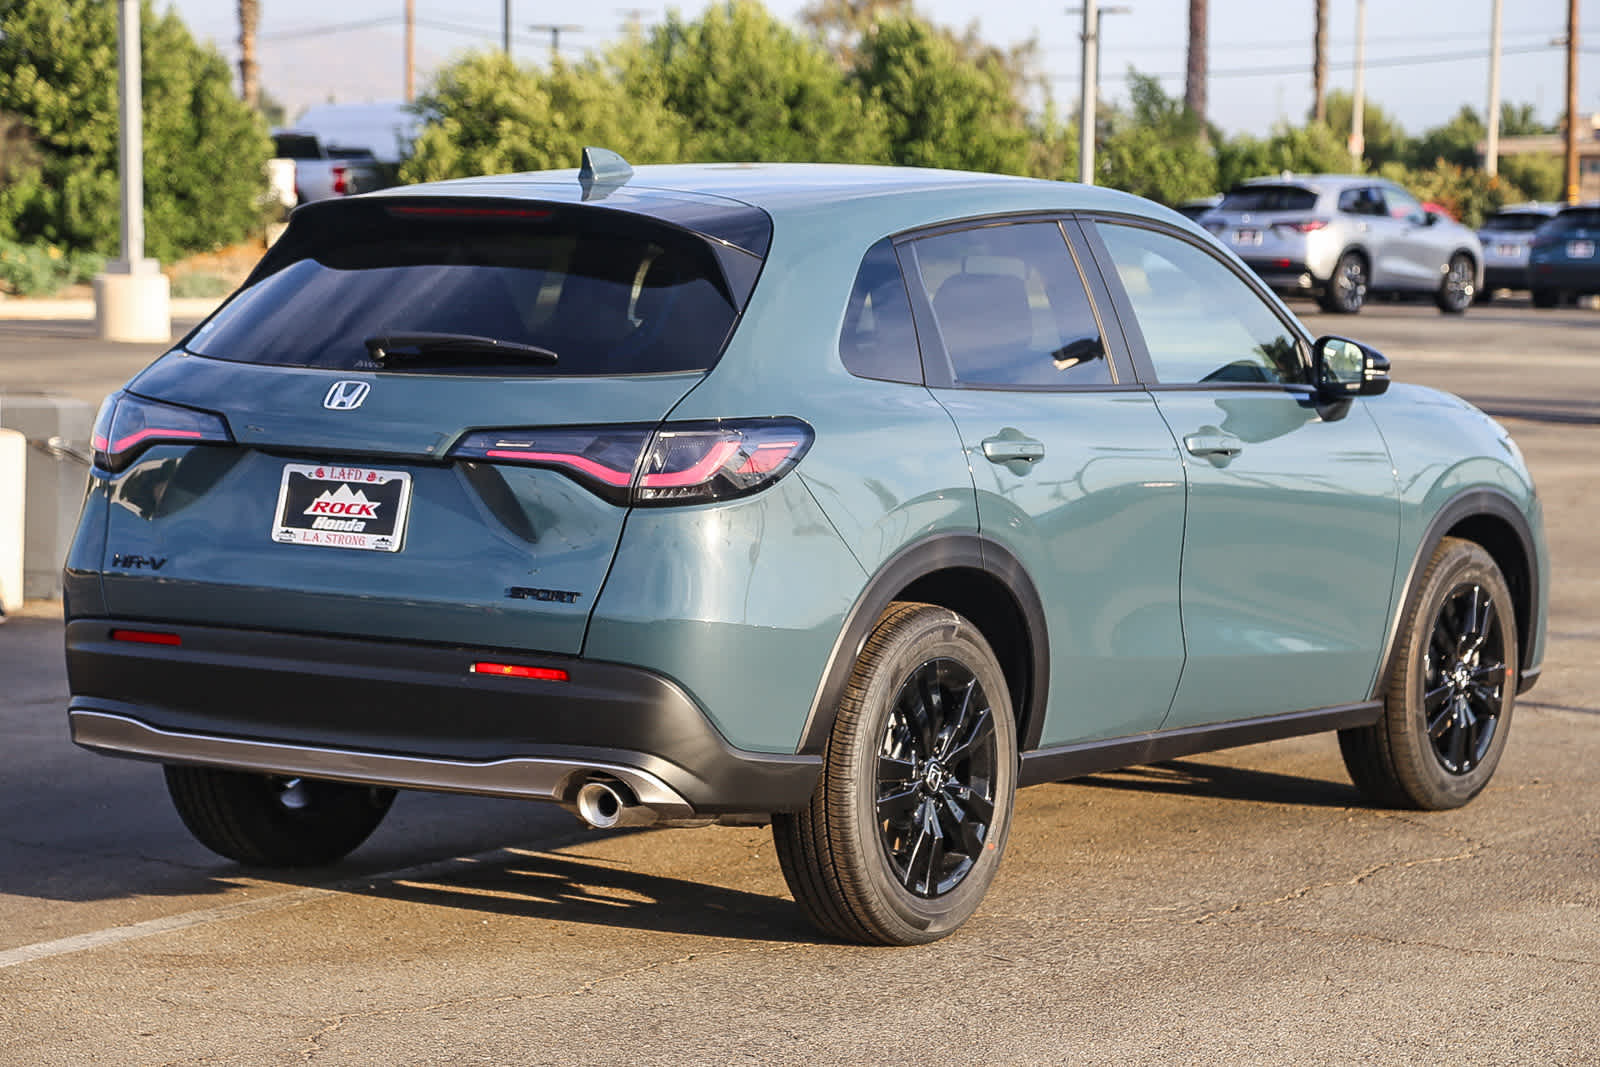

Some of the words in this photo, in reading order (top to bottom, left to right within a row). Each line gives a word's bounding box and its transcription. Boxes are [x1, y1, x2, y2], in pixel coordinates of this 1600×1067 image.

[330, 467, 363, 481] LAFD
[312, 501, 374, 516] ROCK
[312, 516, 366, 532] Honda
[325, 534, 367, 546] STRONG
[111, 553, 168, 570] HR-V
[506, 586, 582, 603] SPORT
